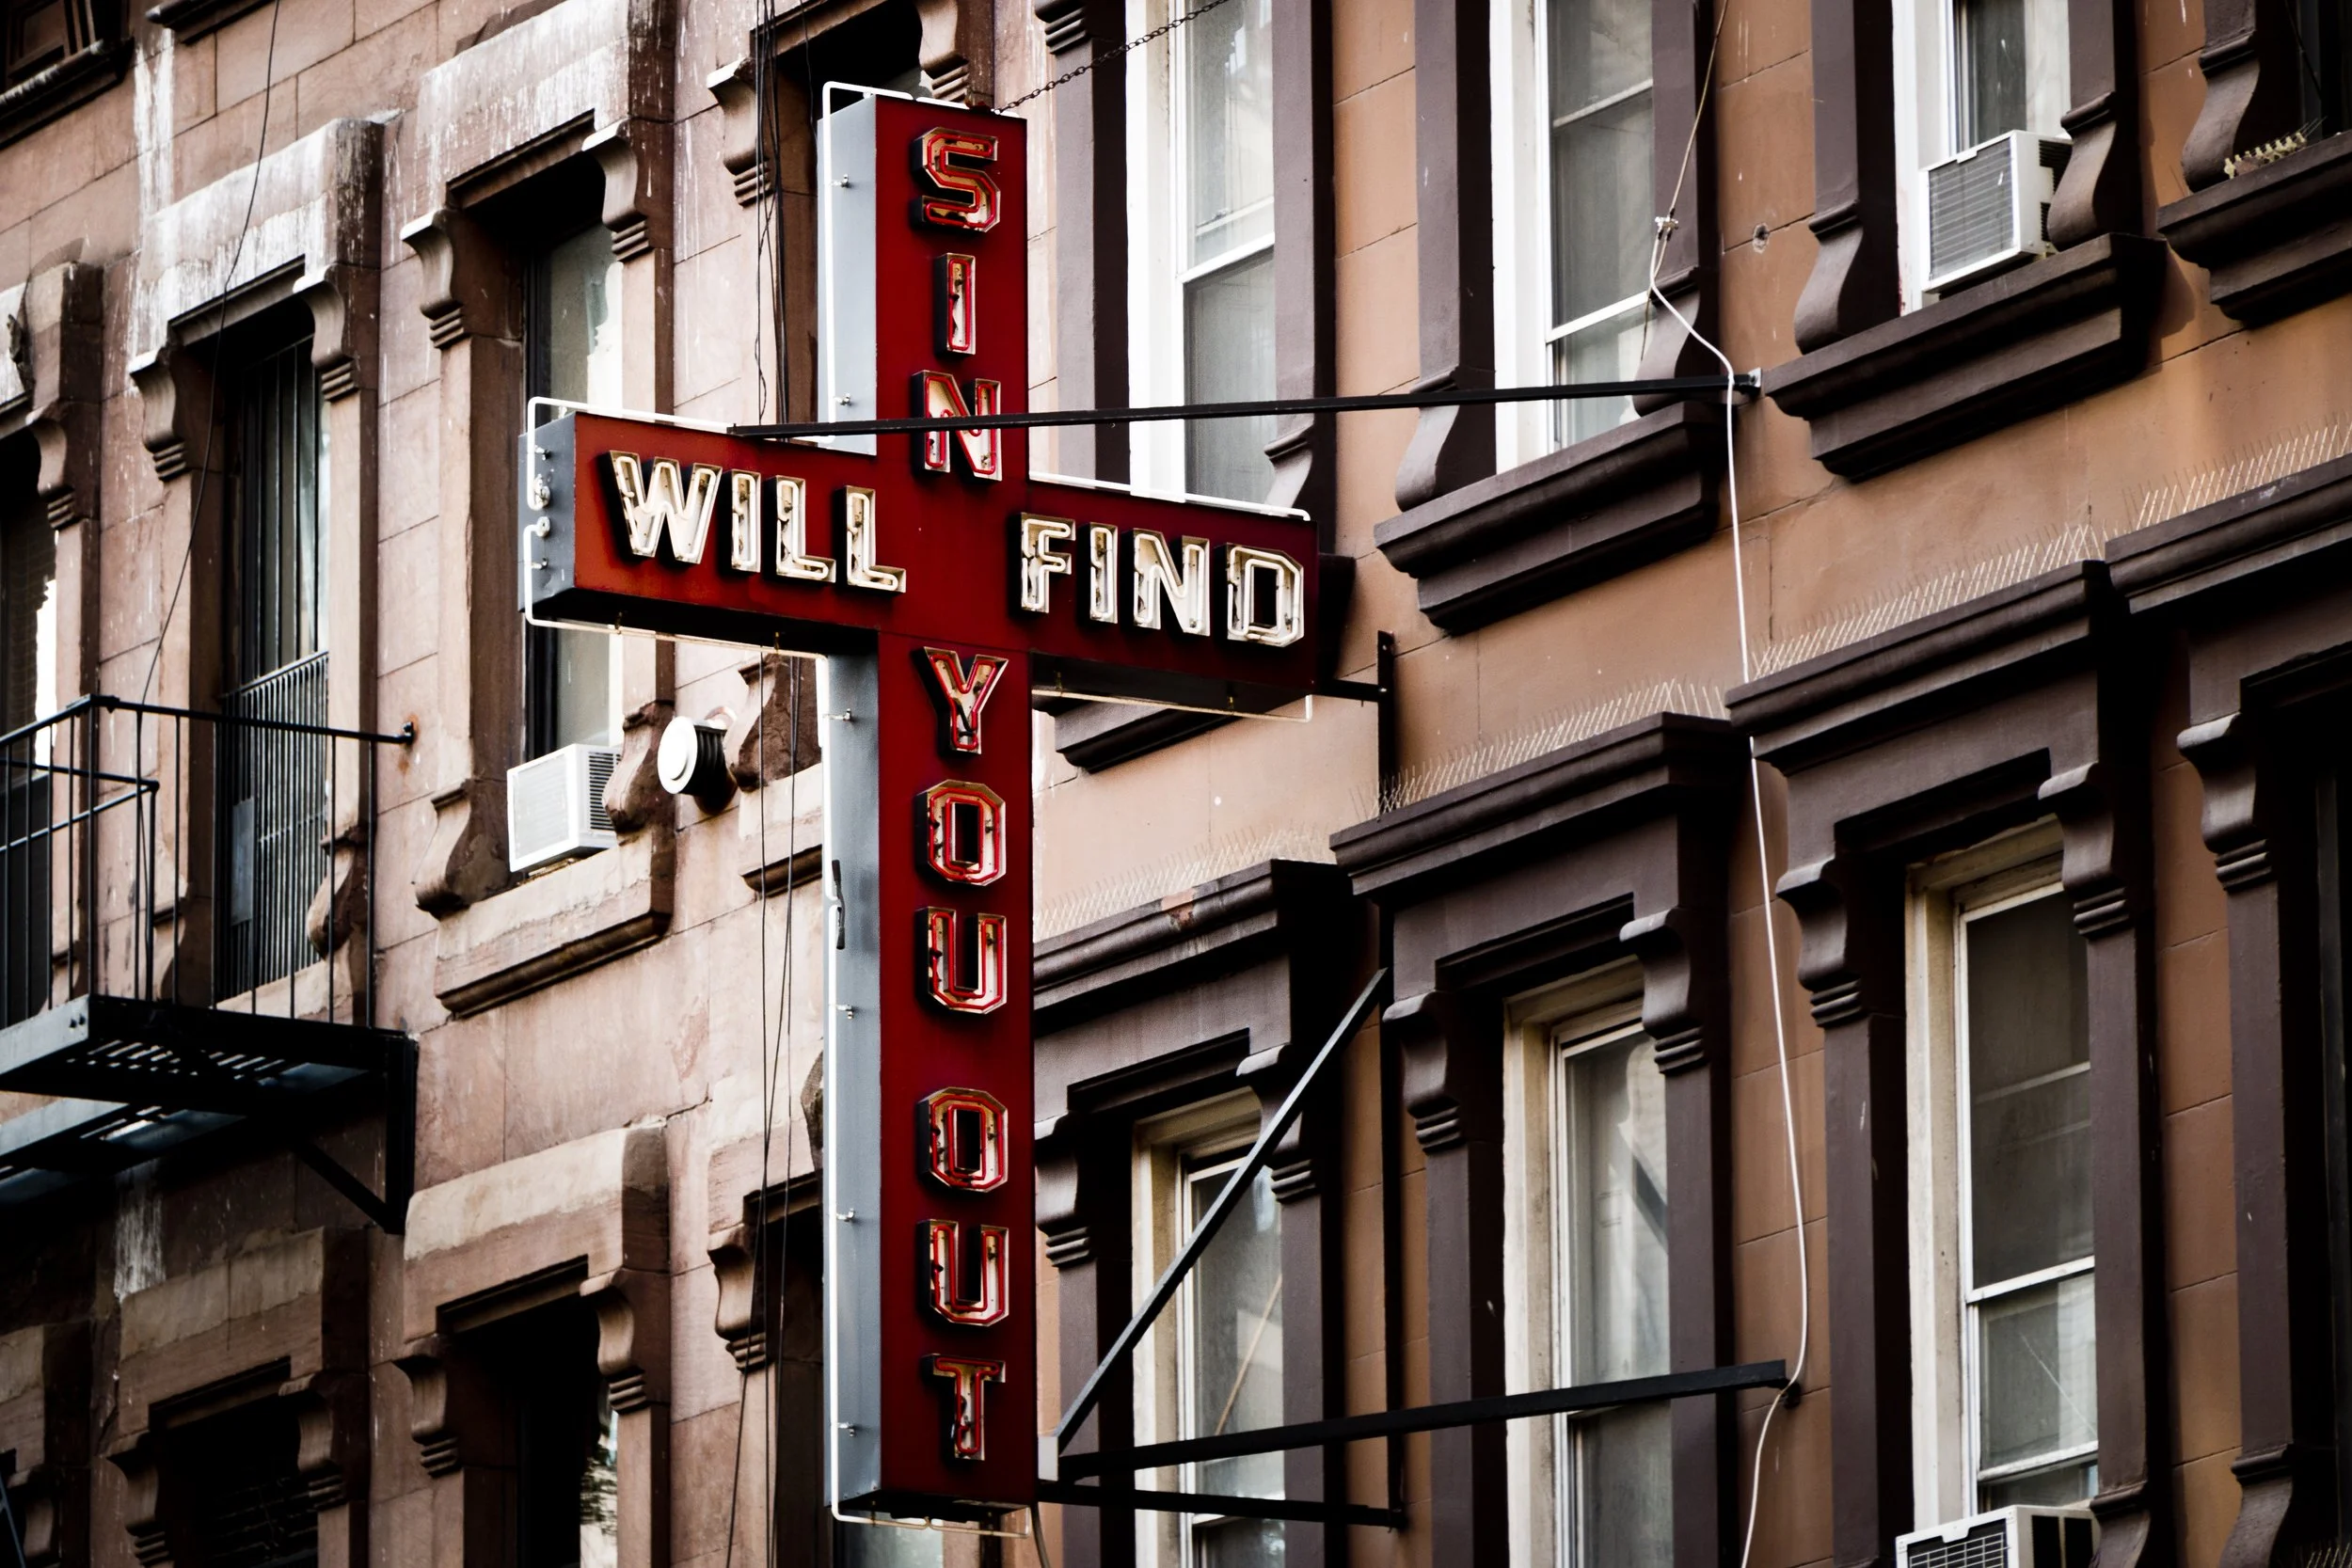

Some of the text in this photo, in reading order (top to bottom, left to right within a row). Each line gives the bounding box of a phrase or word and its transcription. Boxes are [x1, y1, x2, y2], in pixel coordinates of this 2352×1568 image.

[914, 126, 1003, 481] SIN
[607, 451, 1306, 647] WILL FIND
[916, 646, 1009, 1461] YOU OUT
